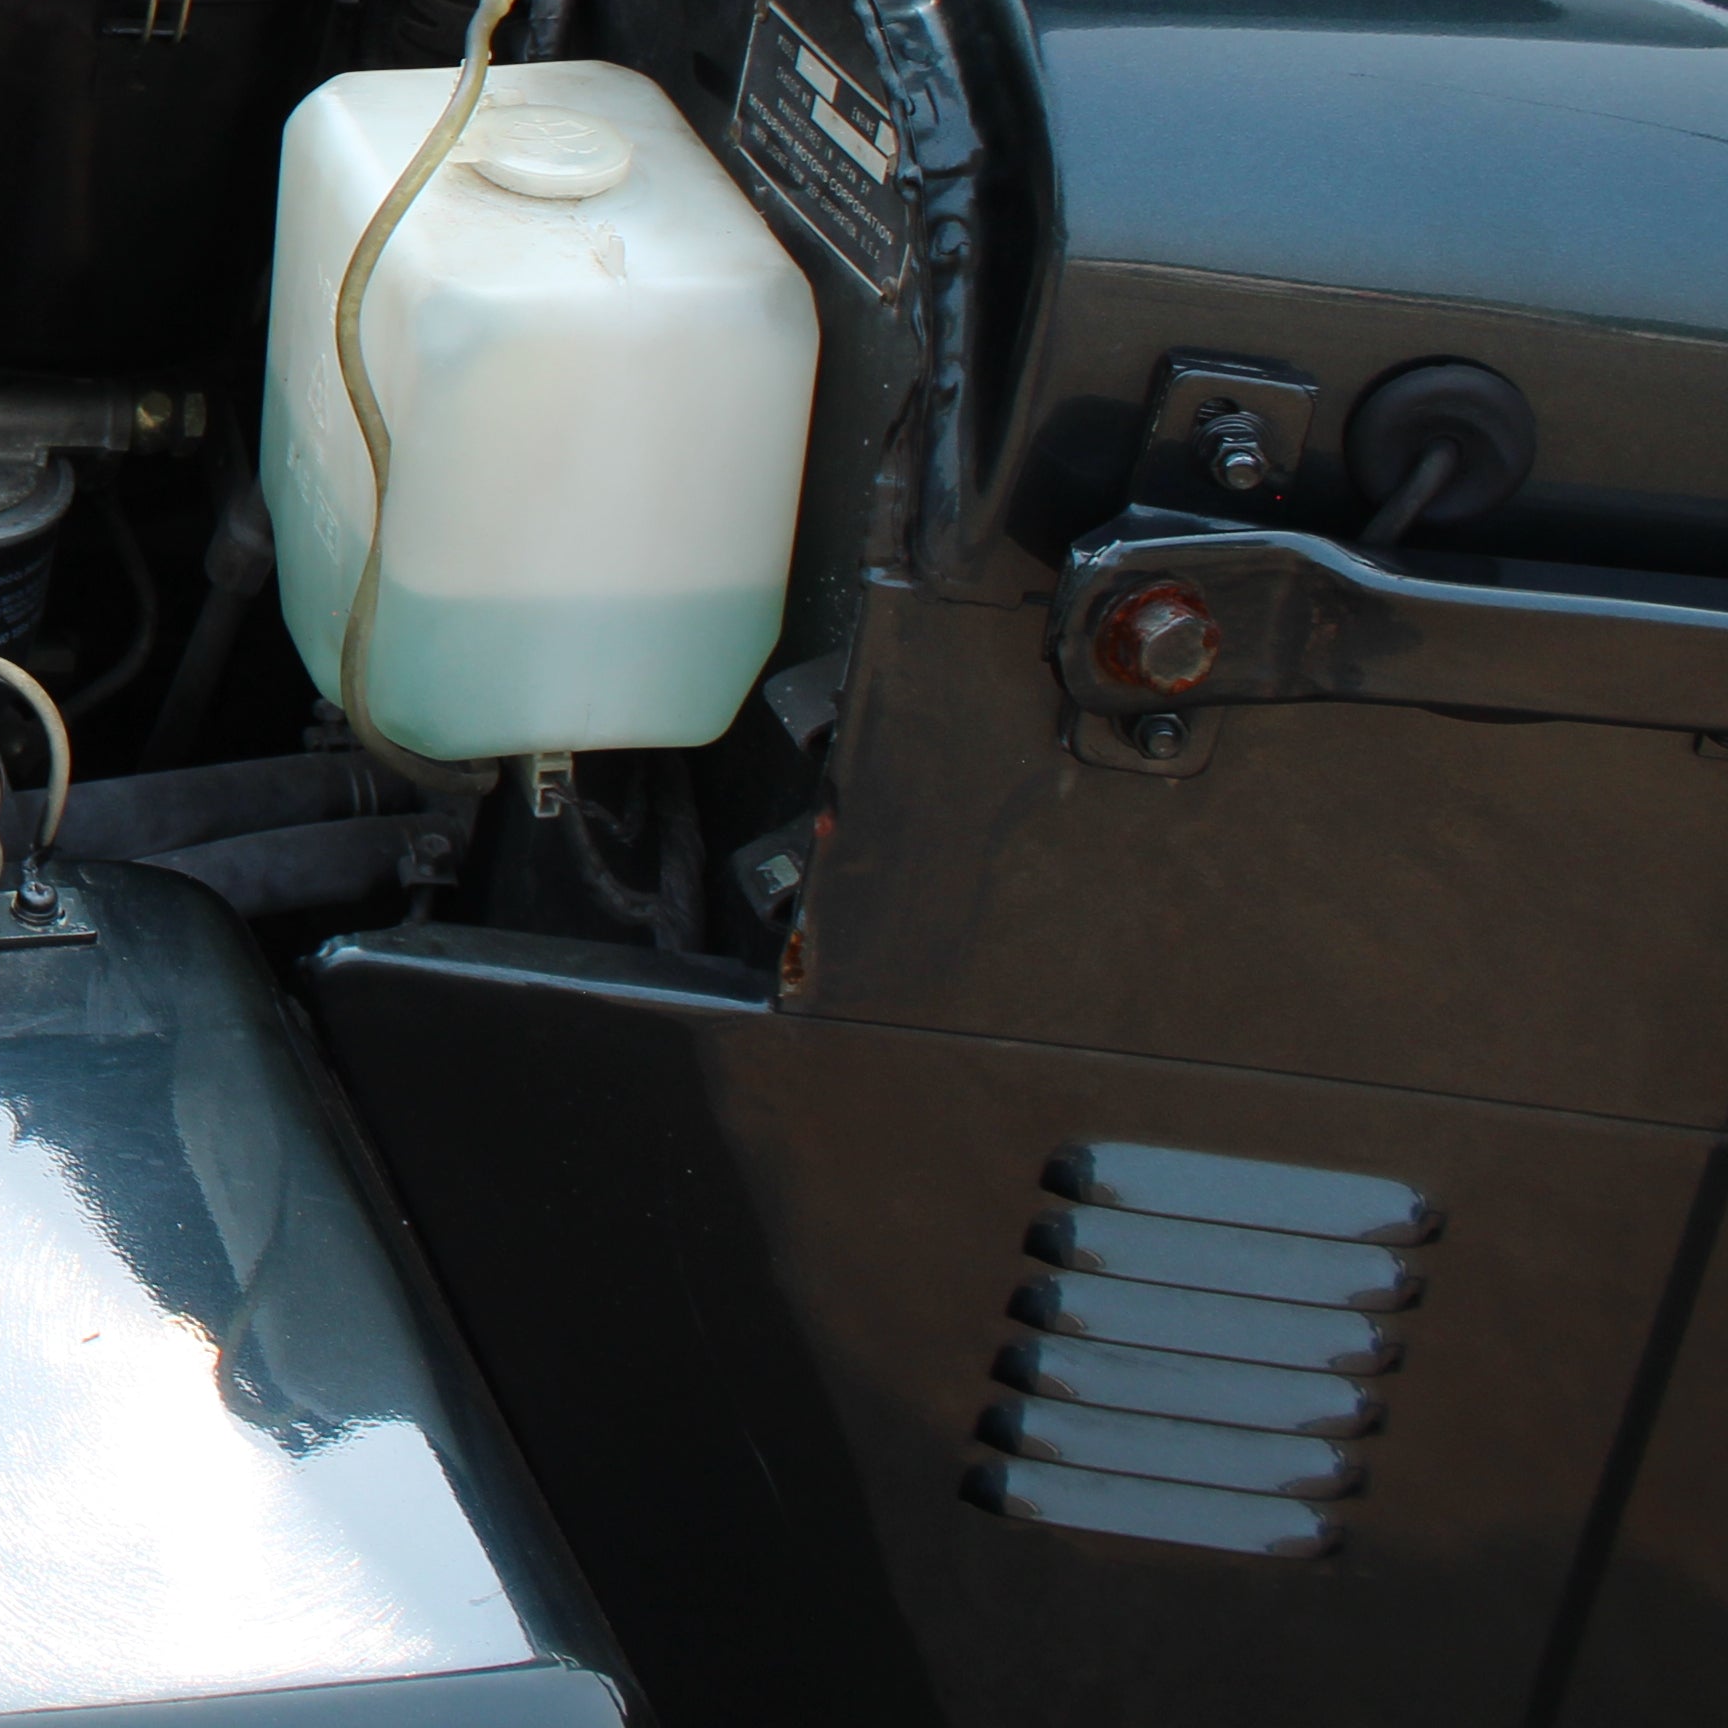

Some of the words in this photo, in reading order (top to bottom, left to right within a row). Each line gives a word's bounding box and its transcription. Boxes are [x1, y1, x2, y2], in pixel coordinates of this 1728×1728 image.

[748, 92, 792, 145] MITSUBISHI
[794, 139, 828, 183] MOTORS
[829, 174, 892, 247] CORPORATION
